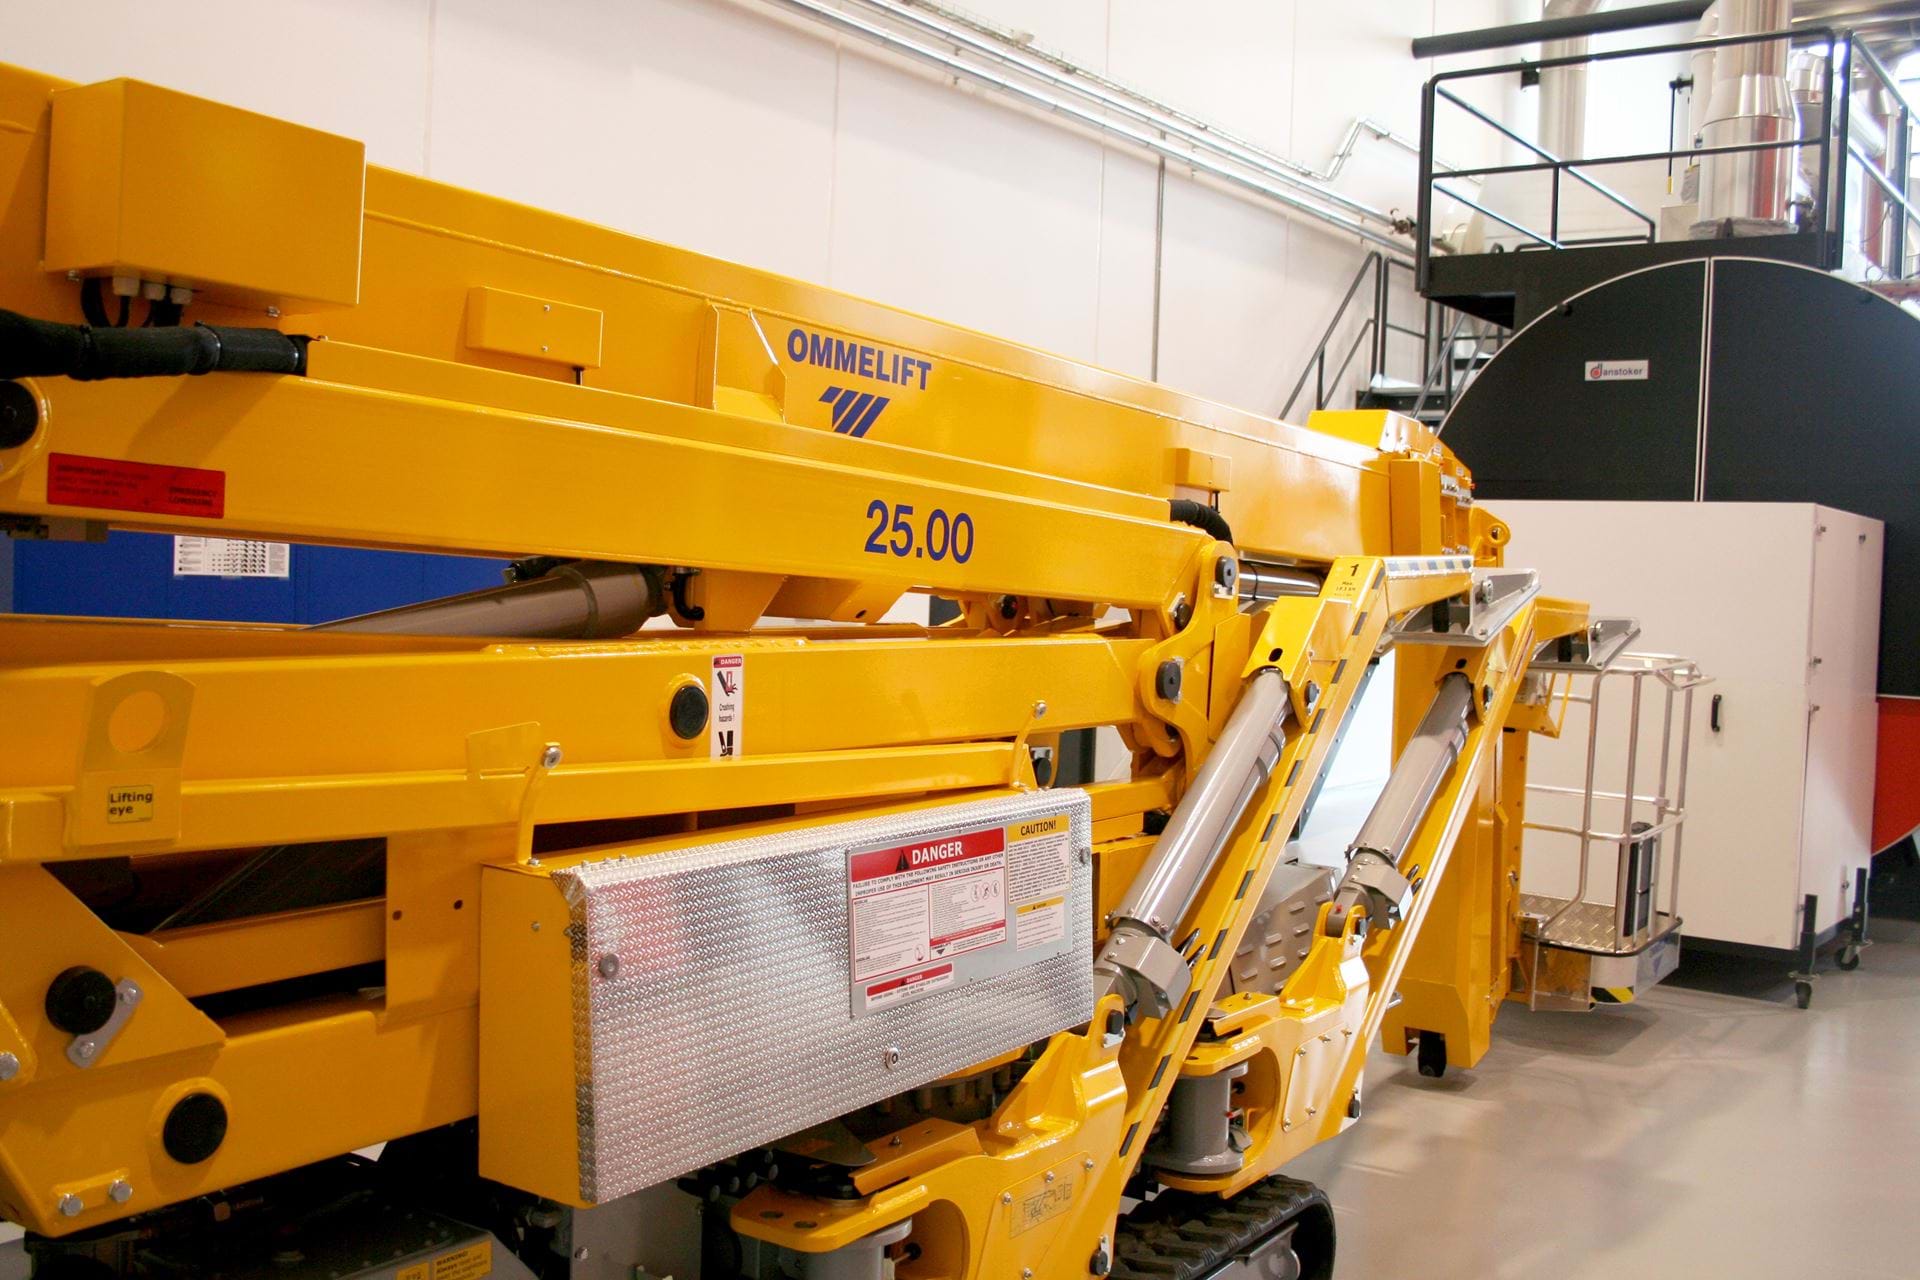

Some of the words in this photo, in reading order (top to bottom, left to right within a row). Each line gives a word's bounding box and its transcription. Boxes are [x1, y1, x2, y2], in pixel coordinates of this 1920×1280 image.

[787, 328, 932, 391] OMMELIFT
[1590, 363, 1643, 379] danstoker
[863, 499, 974, 564] 25.00
[1350, 563, 1359, 577] 1
[110, 791, 153, 804] Lifting
[110, 806, 134, 816] eye
[1020, 820, 1057, 836] CAUTION!
[912, 841, 963, 864] DANGER
